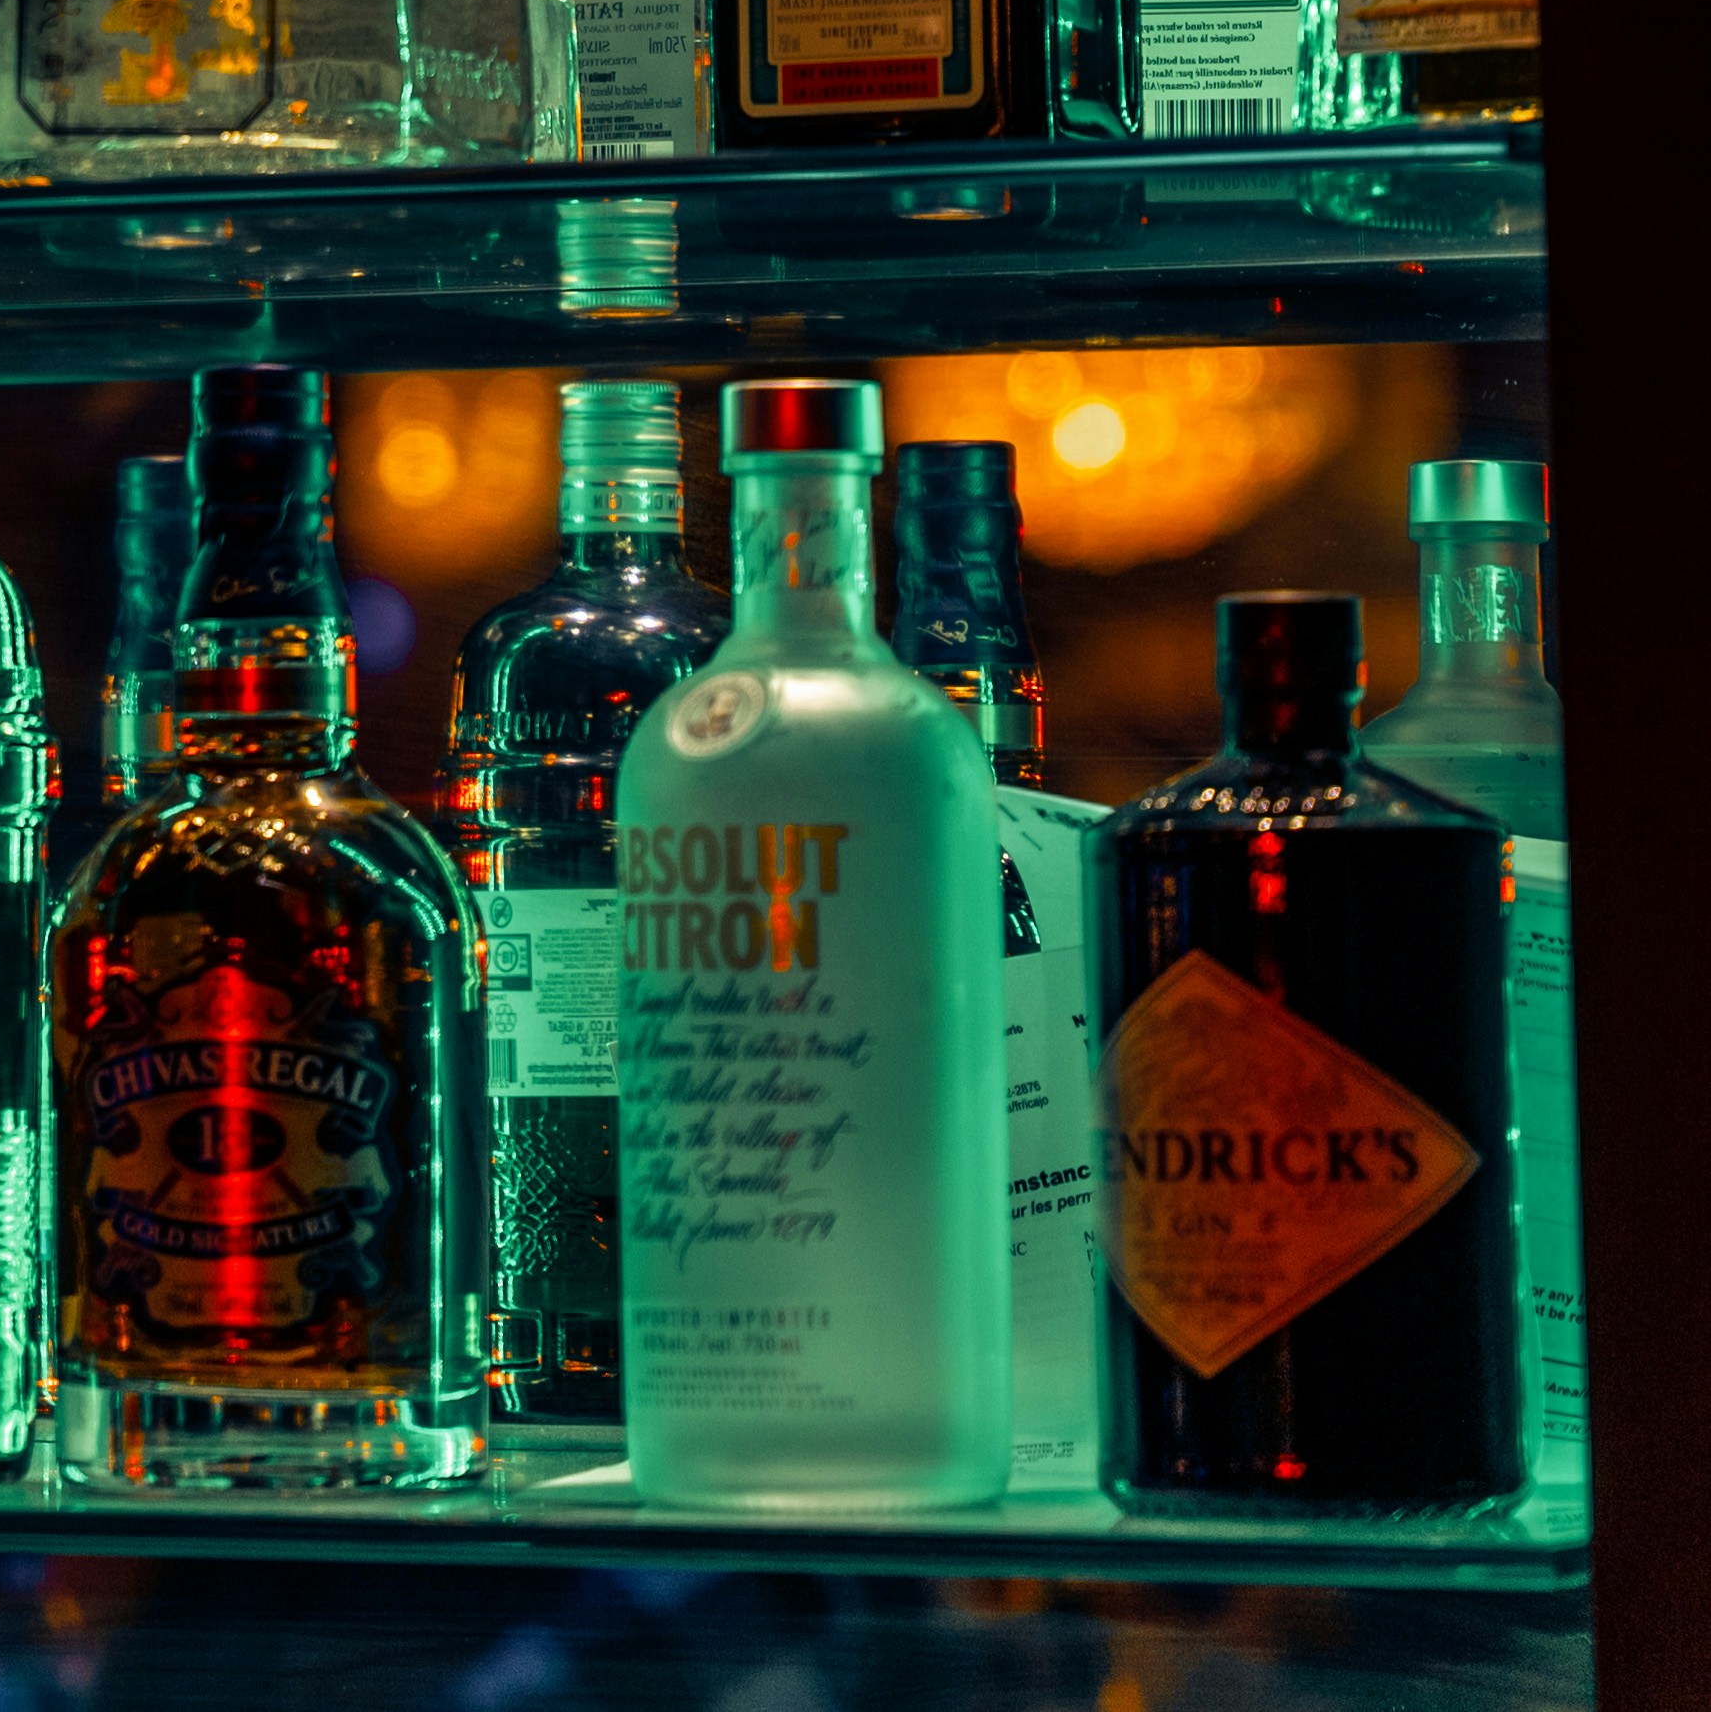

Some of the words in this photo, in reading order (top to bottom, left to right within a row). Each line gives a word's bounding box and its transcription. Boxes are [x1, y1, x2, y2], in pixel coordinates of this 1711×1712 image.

[619, 825, 848, 894] BSOLUT
[93, 1049, 220, 1109] CHIVAS
[1030, 1197, 1053, 1215] les
[1172, 1212, 1232, 1237] GIN
[119, 1209, 186, 1247] GOLD
